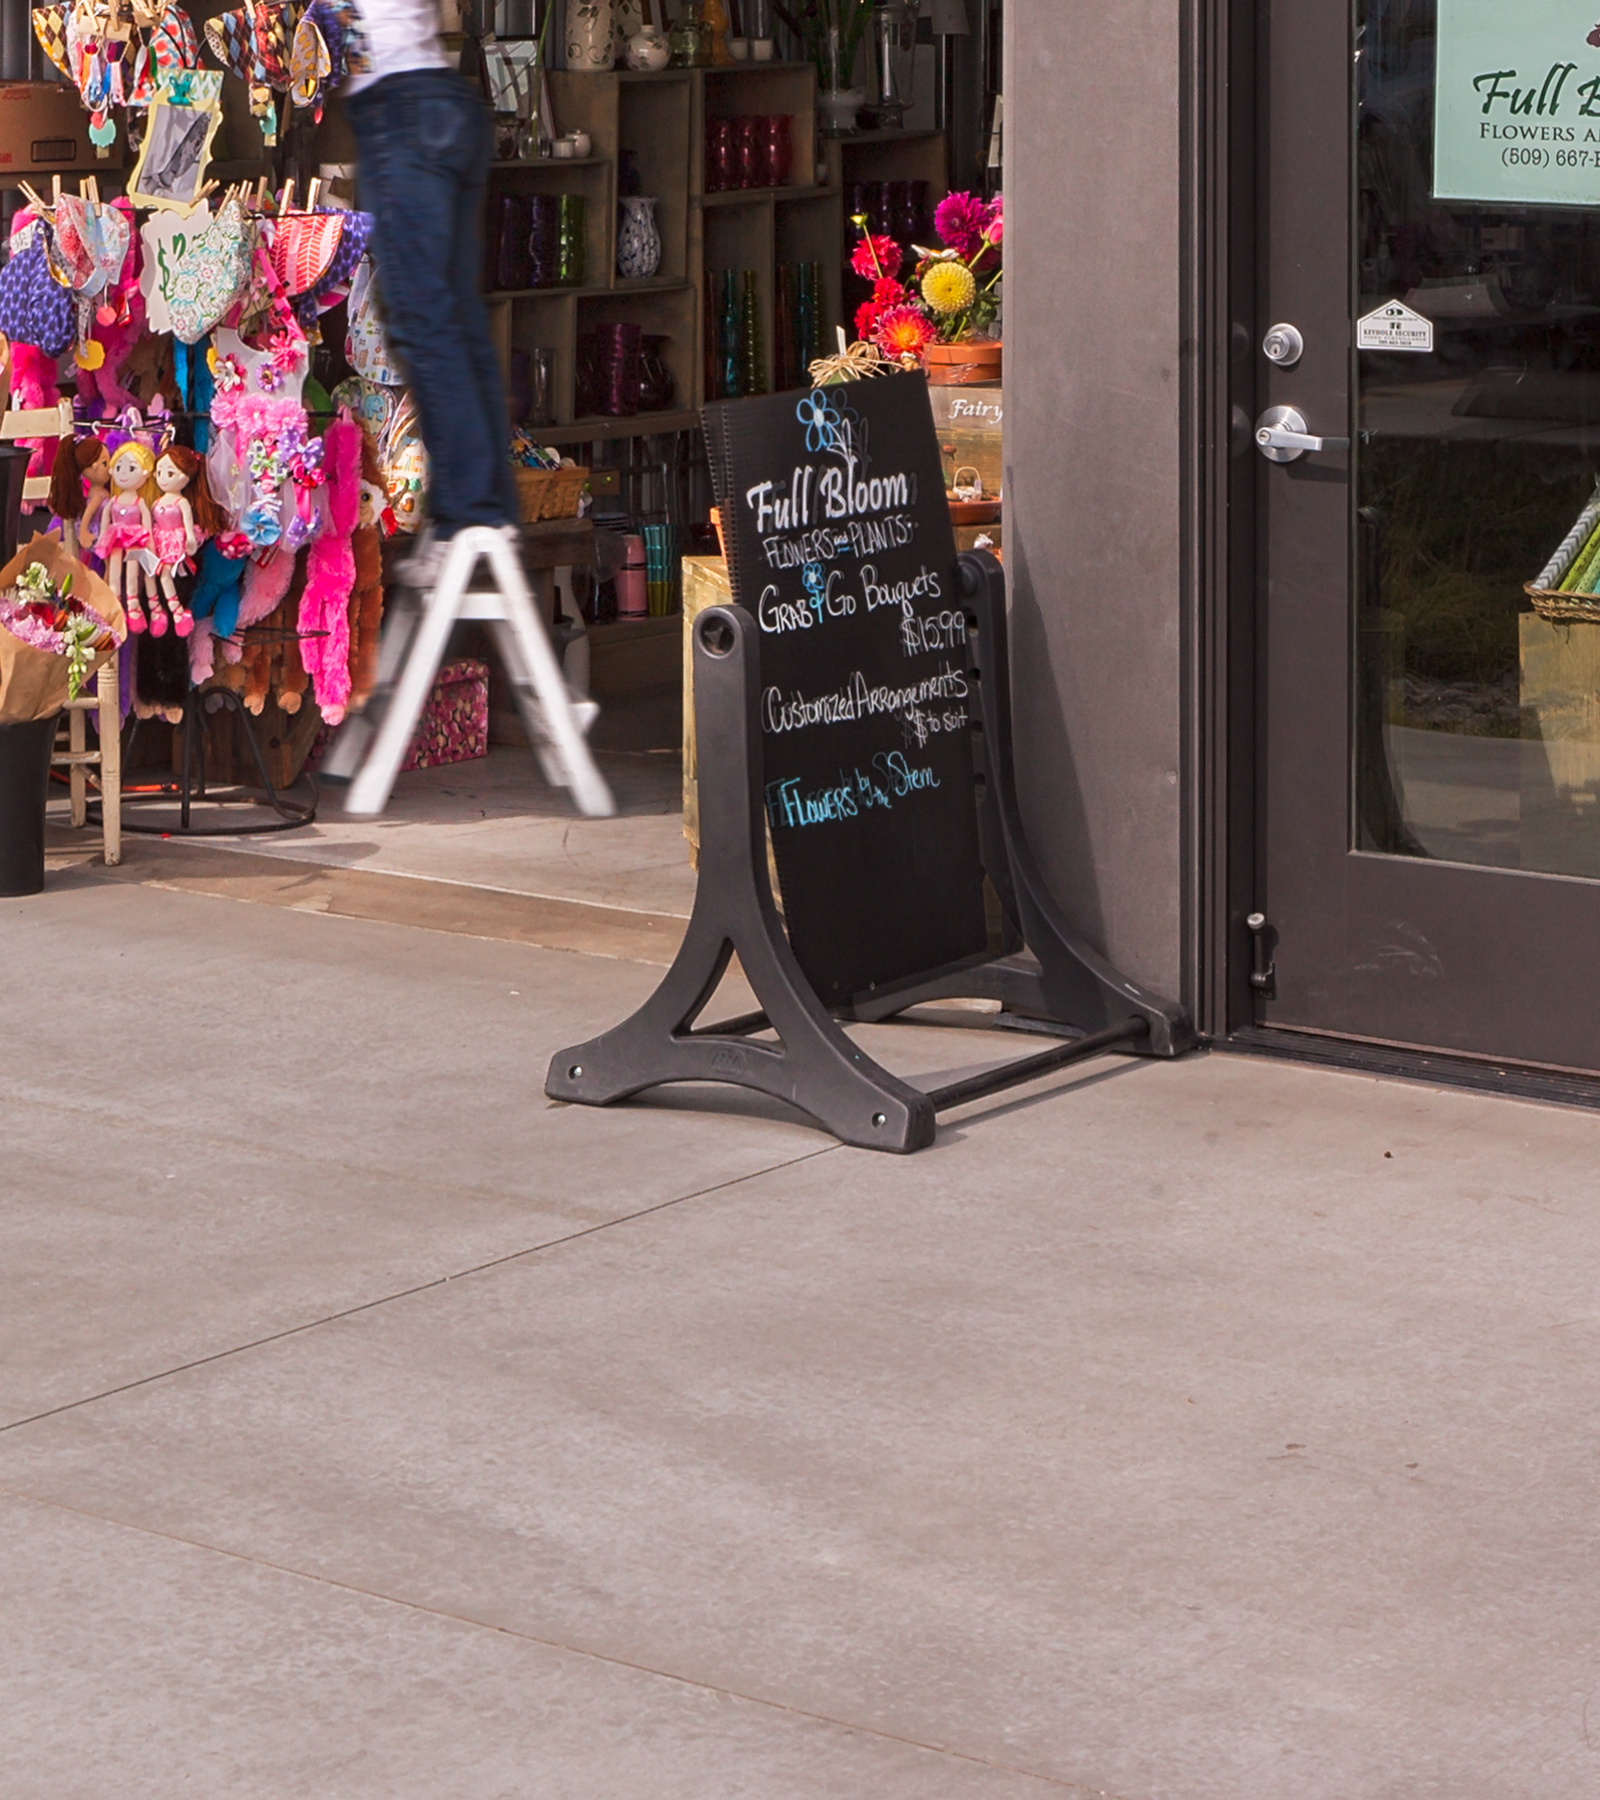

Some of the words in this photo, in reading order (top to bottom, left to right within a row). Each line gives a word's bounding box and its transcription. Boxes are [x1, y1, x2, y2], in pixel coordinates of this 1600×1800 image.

[1472, 62, 1578, 116] Full
[1480, 122, 1575, 141] FLOWERS
[1502, 147, 1550, 169] (509)
[948, 399, 1003, 424] Fairy
[746, 465, 813, 533] Full
[820, 460, 908, 518] Bloom
[763, 528, 834, 569] FLOWERS
[860, 564, 941, 618] Bouquets
[902, 610, 966, 657] $15.99
[768, 686, 856, 733] Customized
[888, 751, 941, 796] Stem
